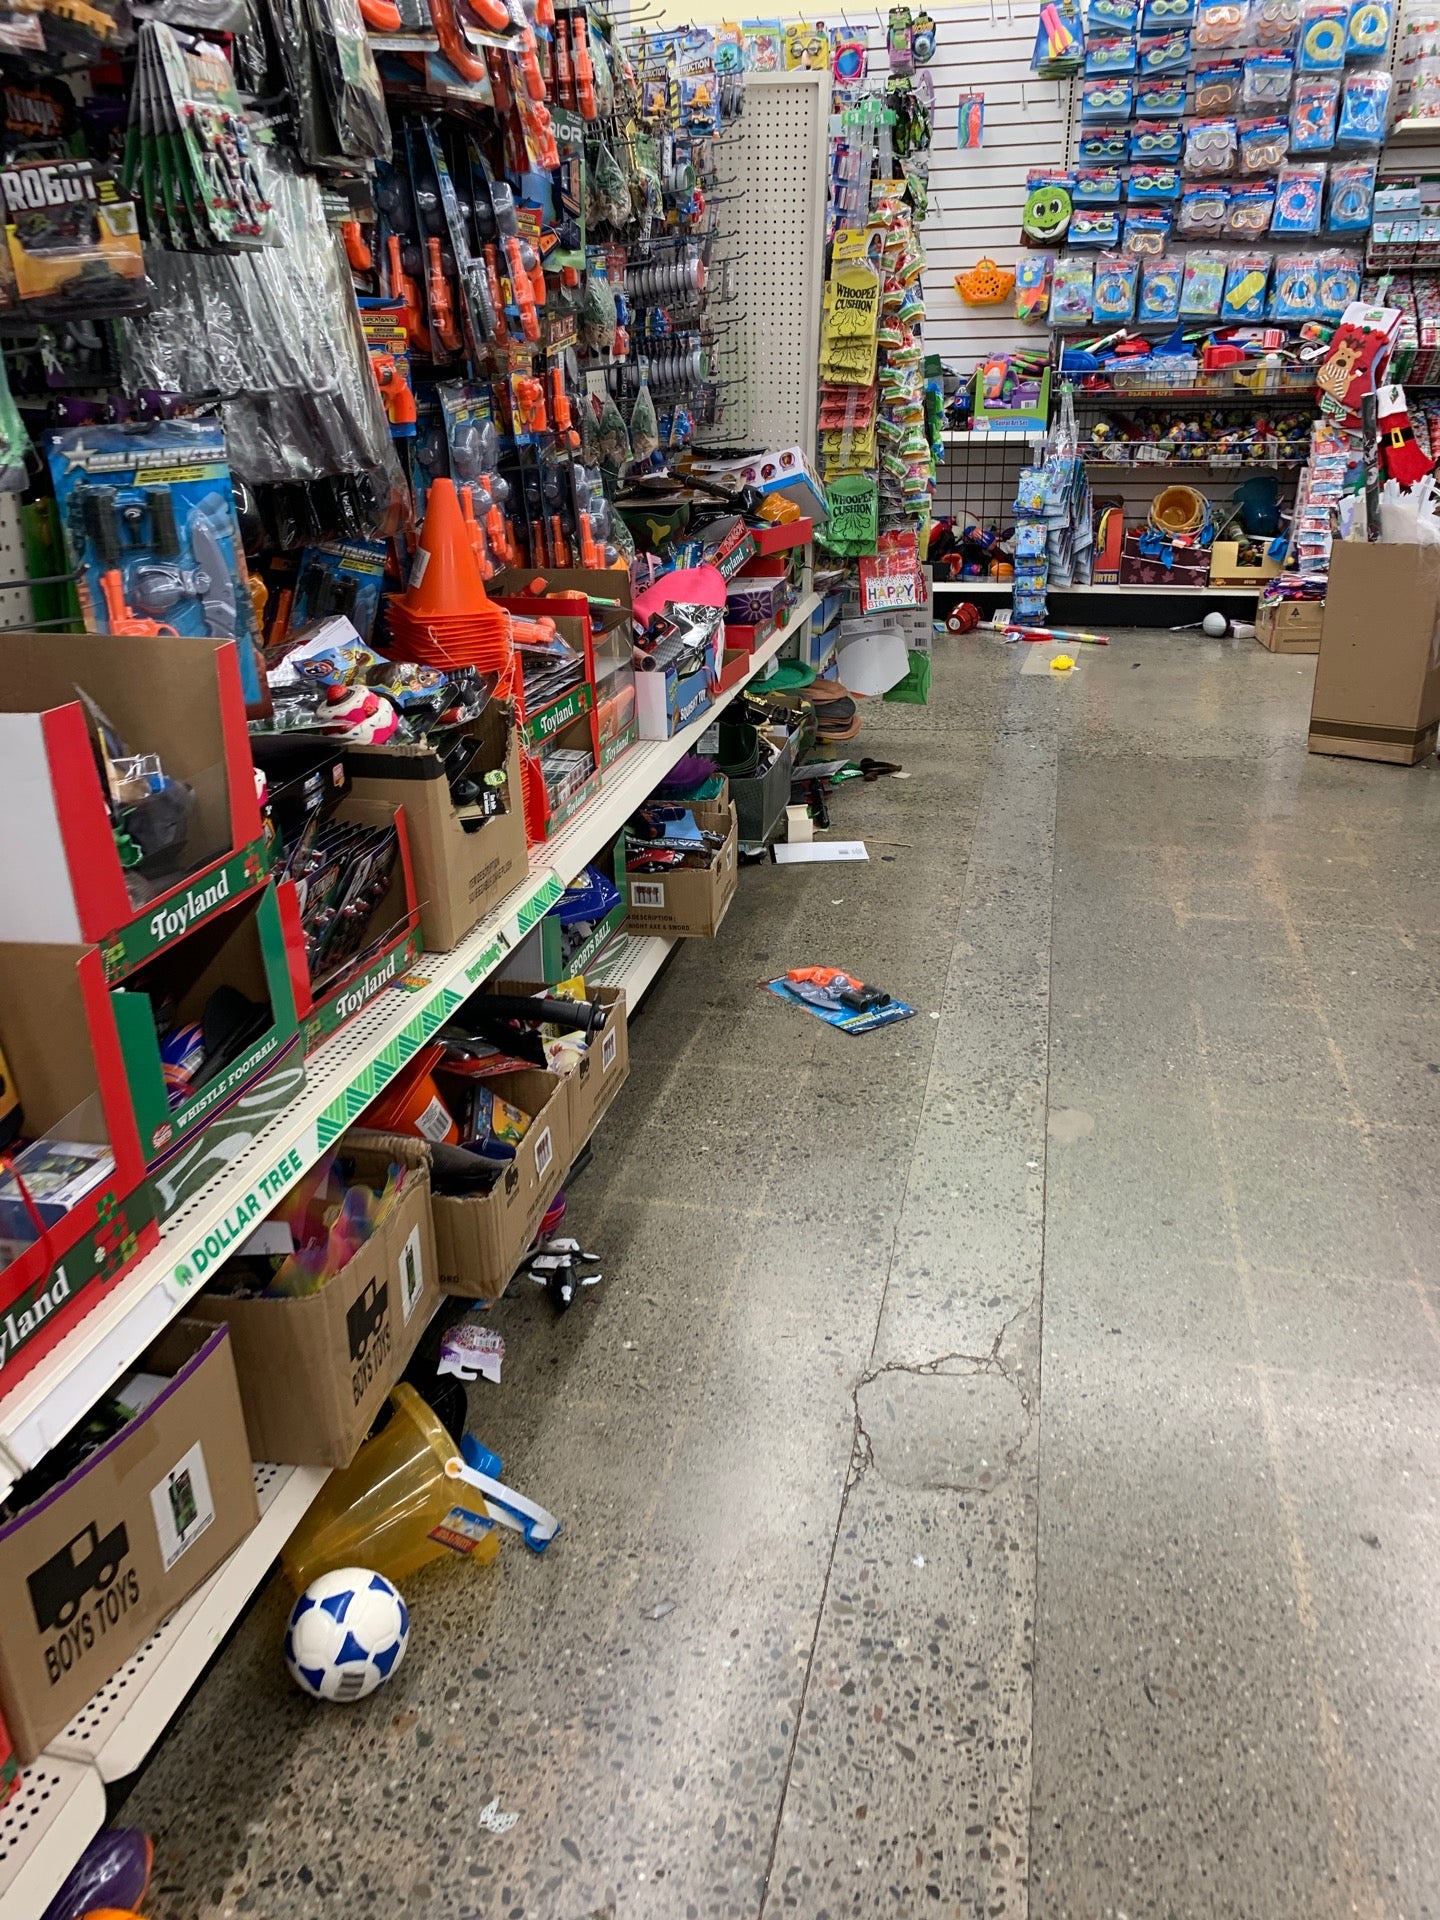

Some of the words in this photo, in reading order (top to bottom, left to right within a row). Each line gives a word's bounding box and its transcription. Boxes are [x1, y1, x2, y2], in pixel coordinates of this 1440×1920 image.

[668, 57, 711, 78] CTRUCTION
[1, 160, 97, 212] ROBOT
[834, 299, 873, 313] CUSHION
[836, 282, 878, 300] WHOOPEE
[830, 488, 874, 505] WHOOPEE
[832, 504, 873, 518] CUSHION
[720, 547, 745, 578] Toyland
[867, 583, 914, 600] HAPPY
[867, 596, 914, 610] BIRTHDAY
[540, 697, 574, 735] Toyland
[150, 868, 231, 942] Toyland
[569, 943, 596, 979] SPORTS
[594, 919, 611, 949] BALL
[335, 953, 396, 1020] Toyland
[176, 1079, 227, 1129] WHISTLE
[227, 1036, 279, 1087] FOOTBALL
[191, 1193, 262, 1275] DOLLAR
[258, 1148, 303, 1201] TREE
[352, 1356, 373, 1408] BOYS
[372, 1320, 392, 1374] TOYS
[43, 1612, 96, 1686] BOYS
[94, 1567, 140, 1636] TOYS
